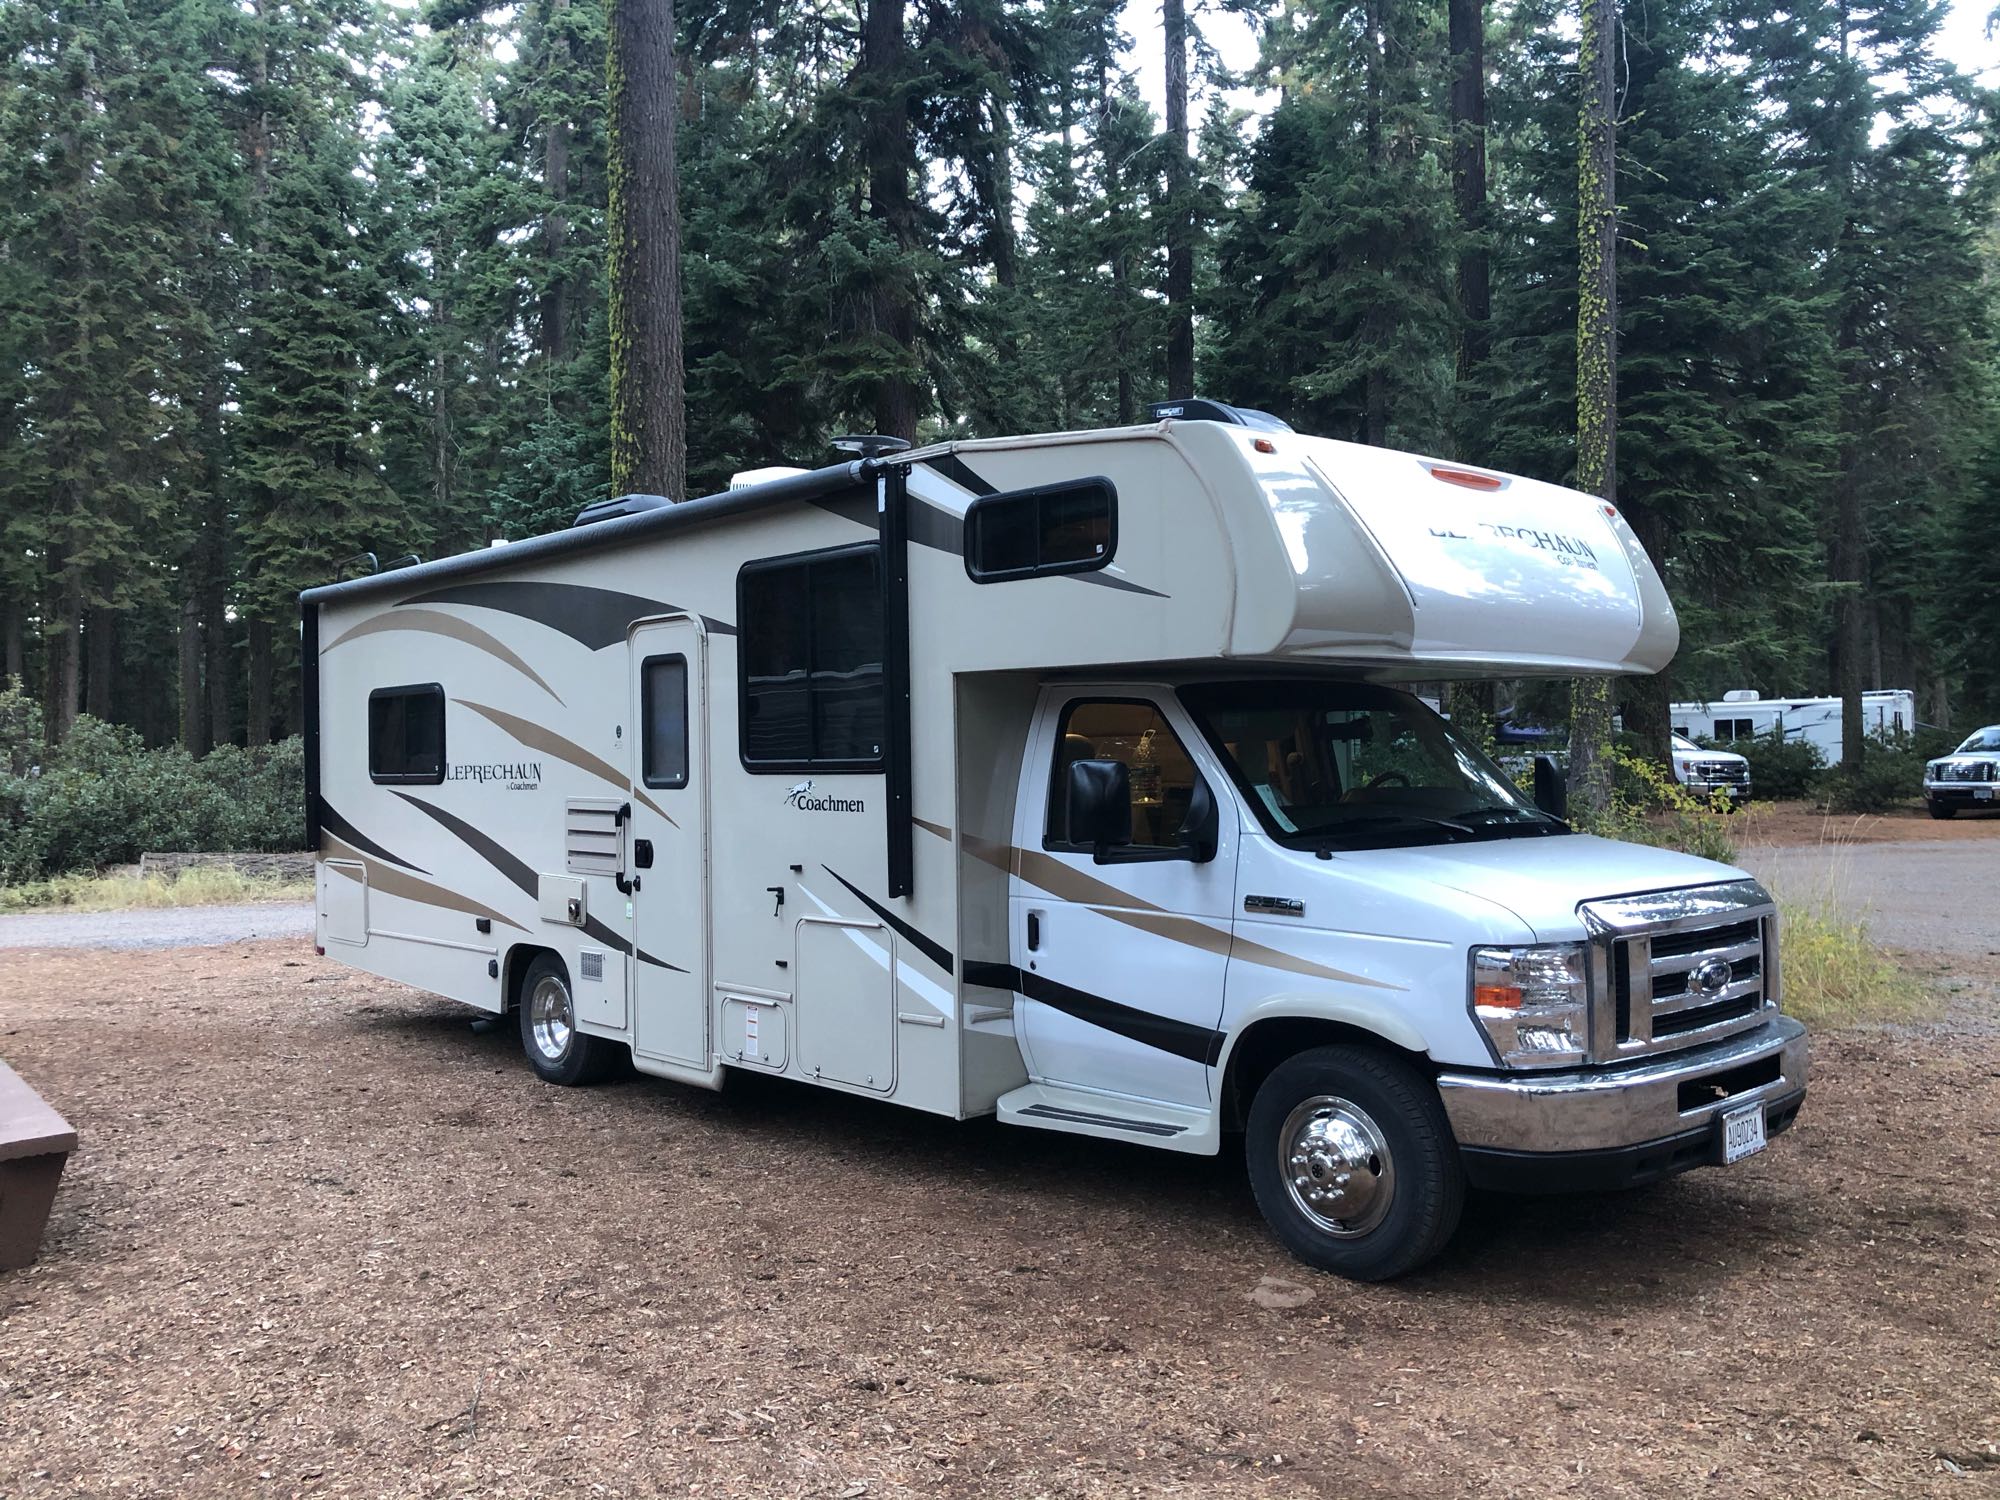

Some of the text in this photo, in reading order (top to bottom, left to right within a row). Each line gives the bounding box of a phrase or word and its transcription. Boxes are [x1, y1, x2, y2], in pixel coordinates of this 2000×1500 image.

[446, 762, 542, 783] LEPRECHAUN
[510, 781, 538, 791] Coachmen
[797, 794, 865, 813] Coachmen
